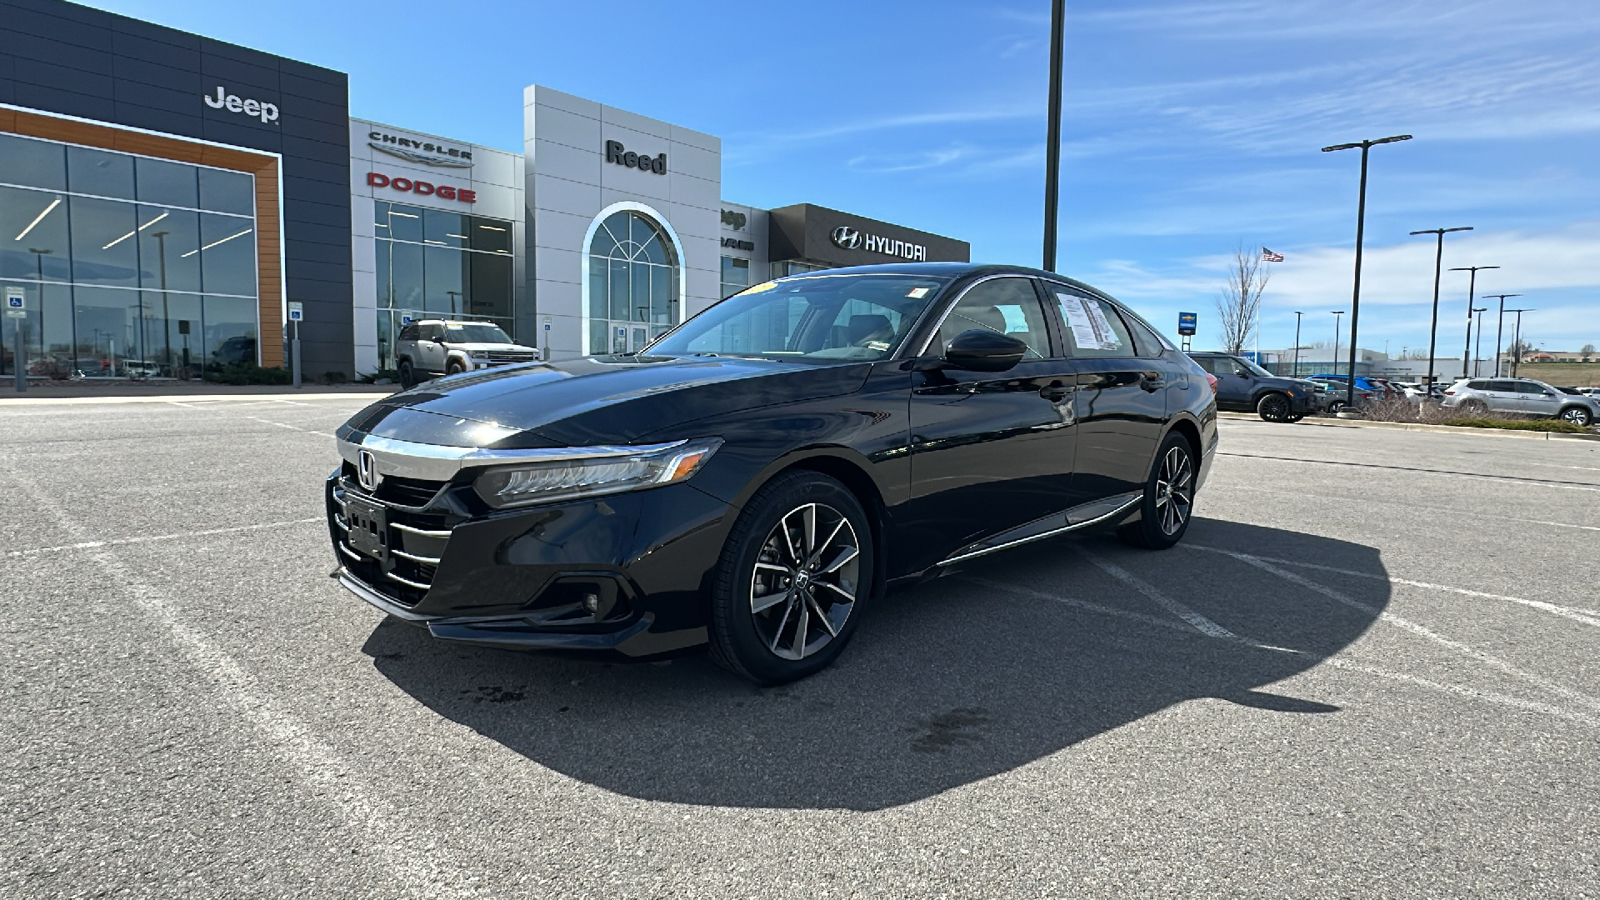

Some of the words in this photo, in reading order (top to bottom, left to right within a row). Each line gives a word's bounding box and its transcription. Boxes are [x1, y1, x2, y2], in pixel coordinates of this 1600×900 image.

[204, 86, 279, 123] Jeep
[368, 132, 472, 160] CHRYSLER
[606, 140, 667, 175] Reed
[367, 172, 477, 204] DODGE
[866, 233, 926, 262] HYUNDAI
